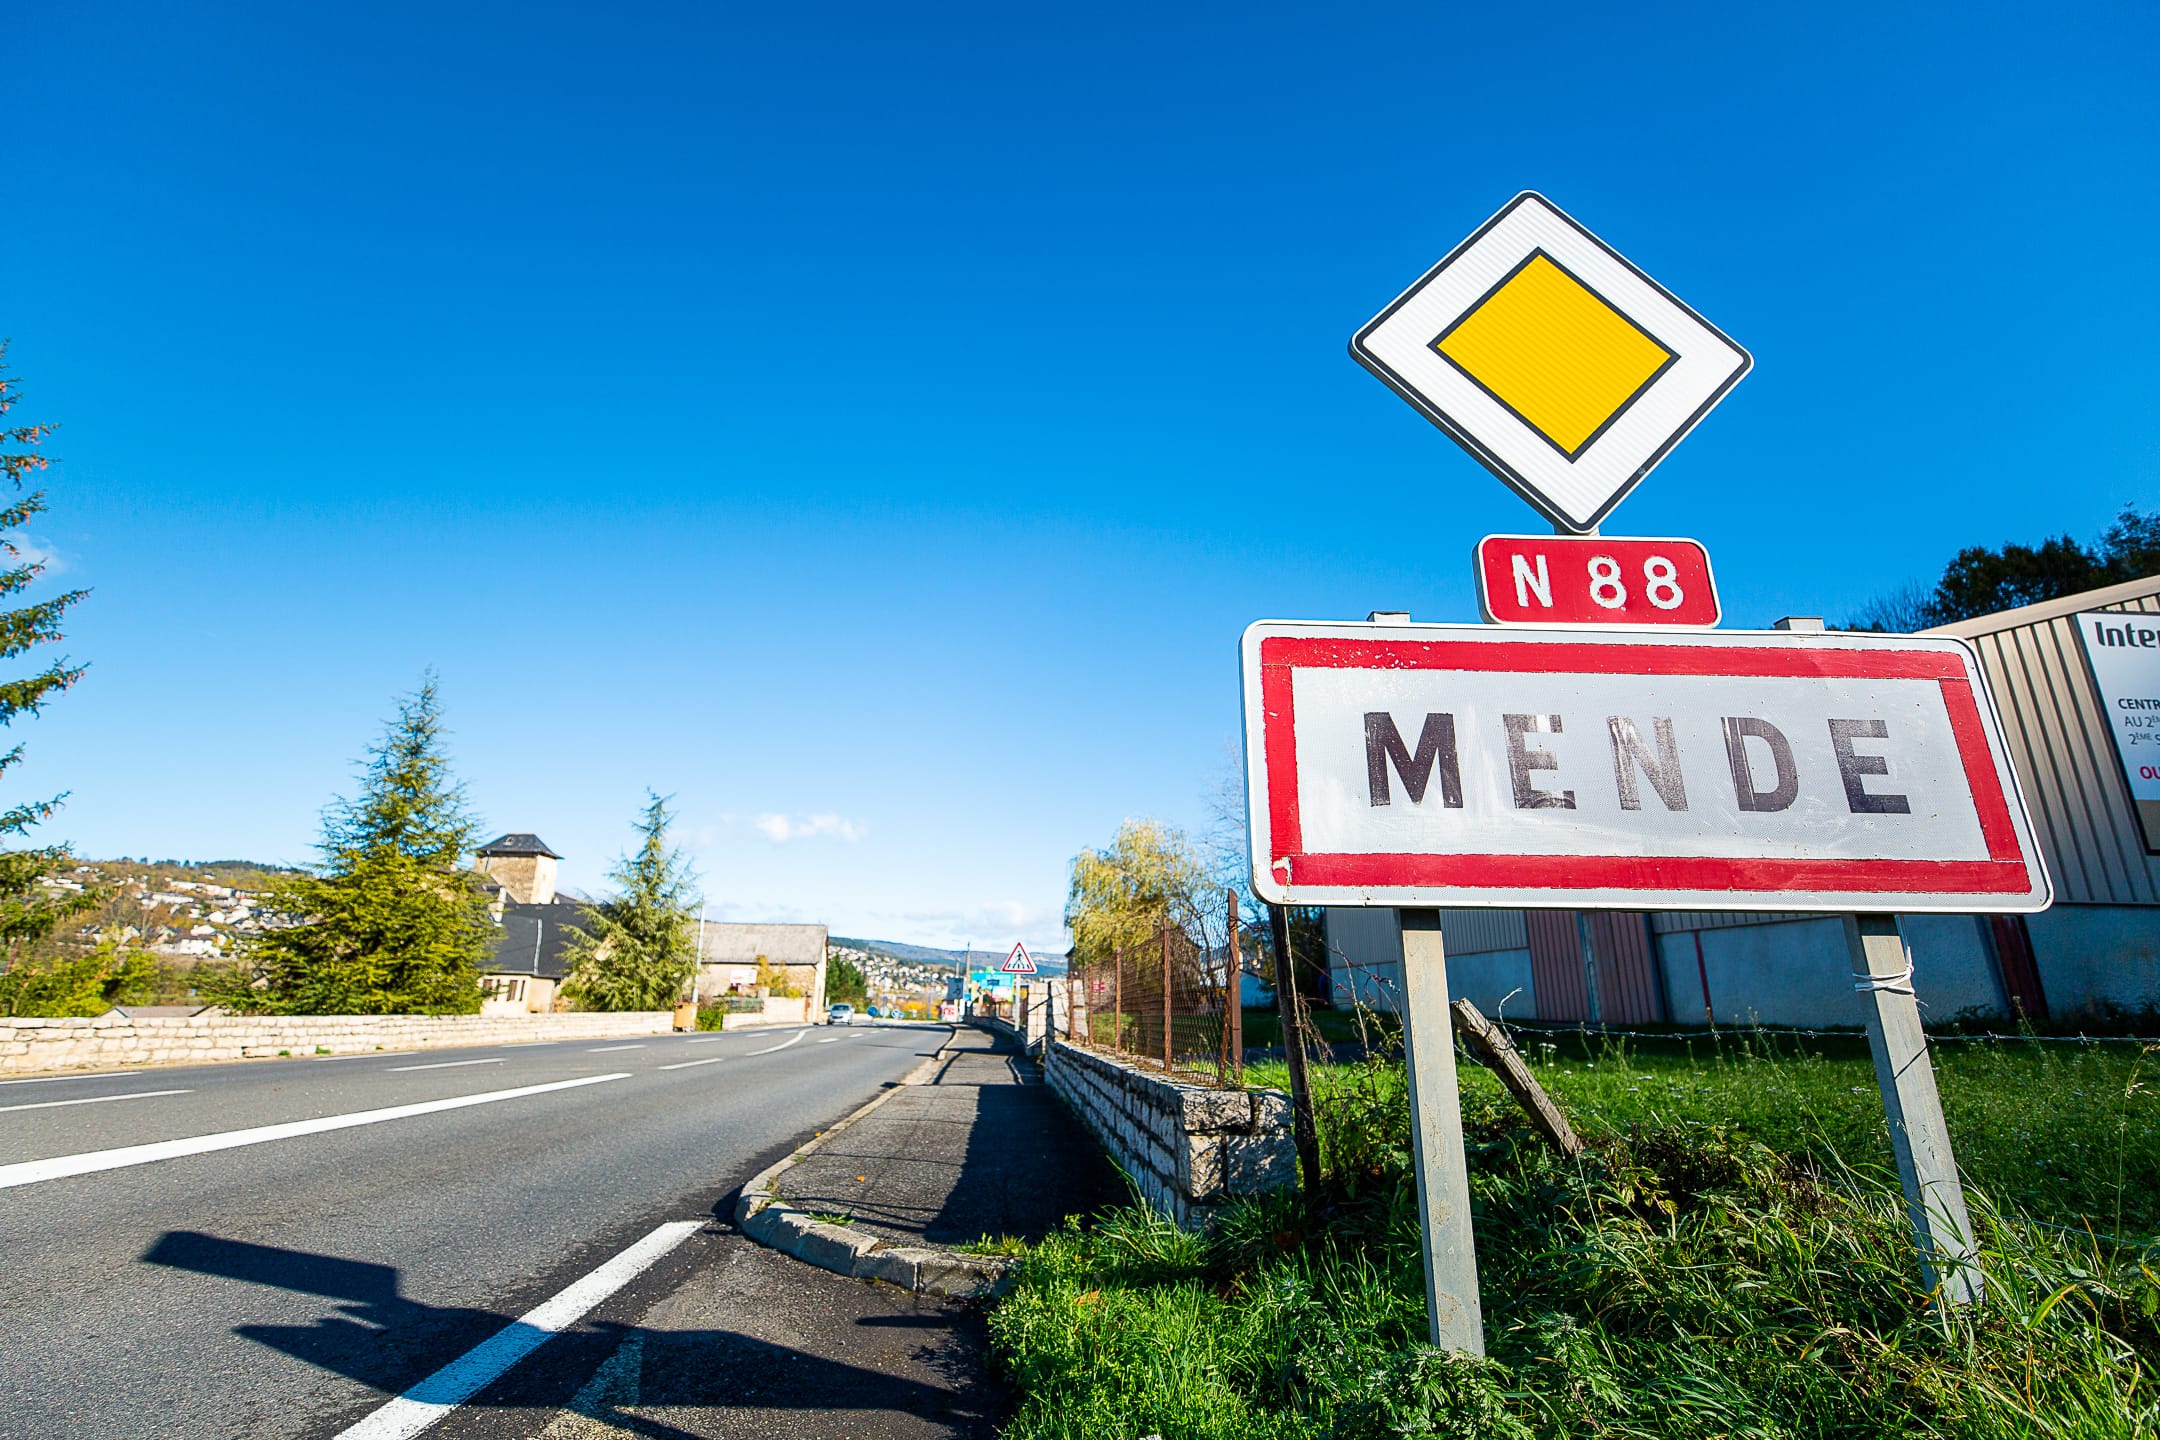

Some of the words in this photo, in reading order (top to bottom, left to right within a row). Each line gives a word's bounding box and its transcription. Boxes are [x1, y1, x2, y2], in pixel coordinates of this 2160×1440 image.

[1511, 554, 1554, 608] N
[1587, 555, 1684, 610] 88
[2125, 716, 2143, 728] AU
[1363, 711, 1911, 814] MENDE
